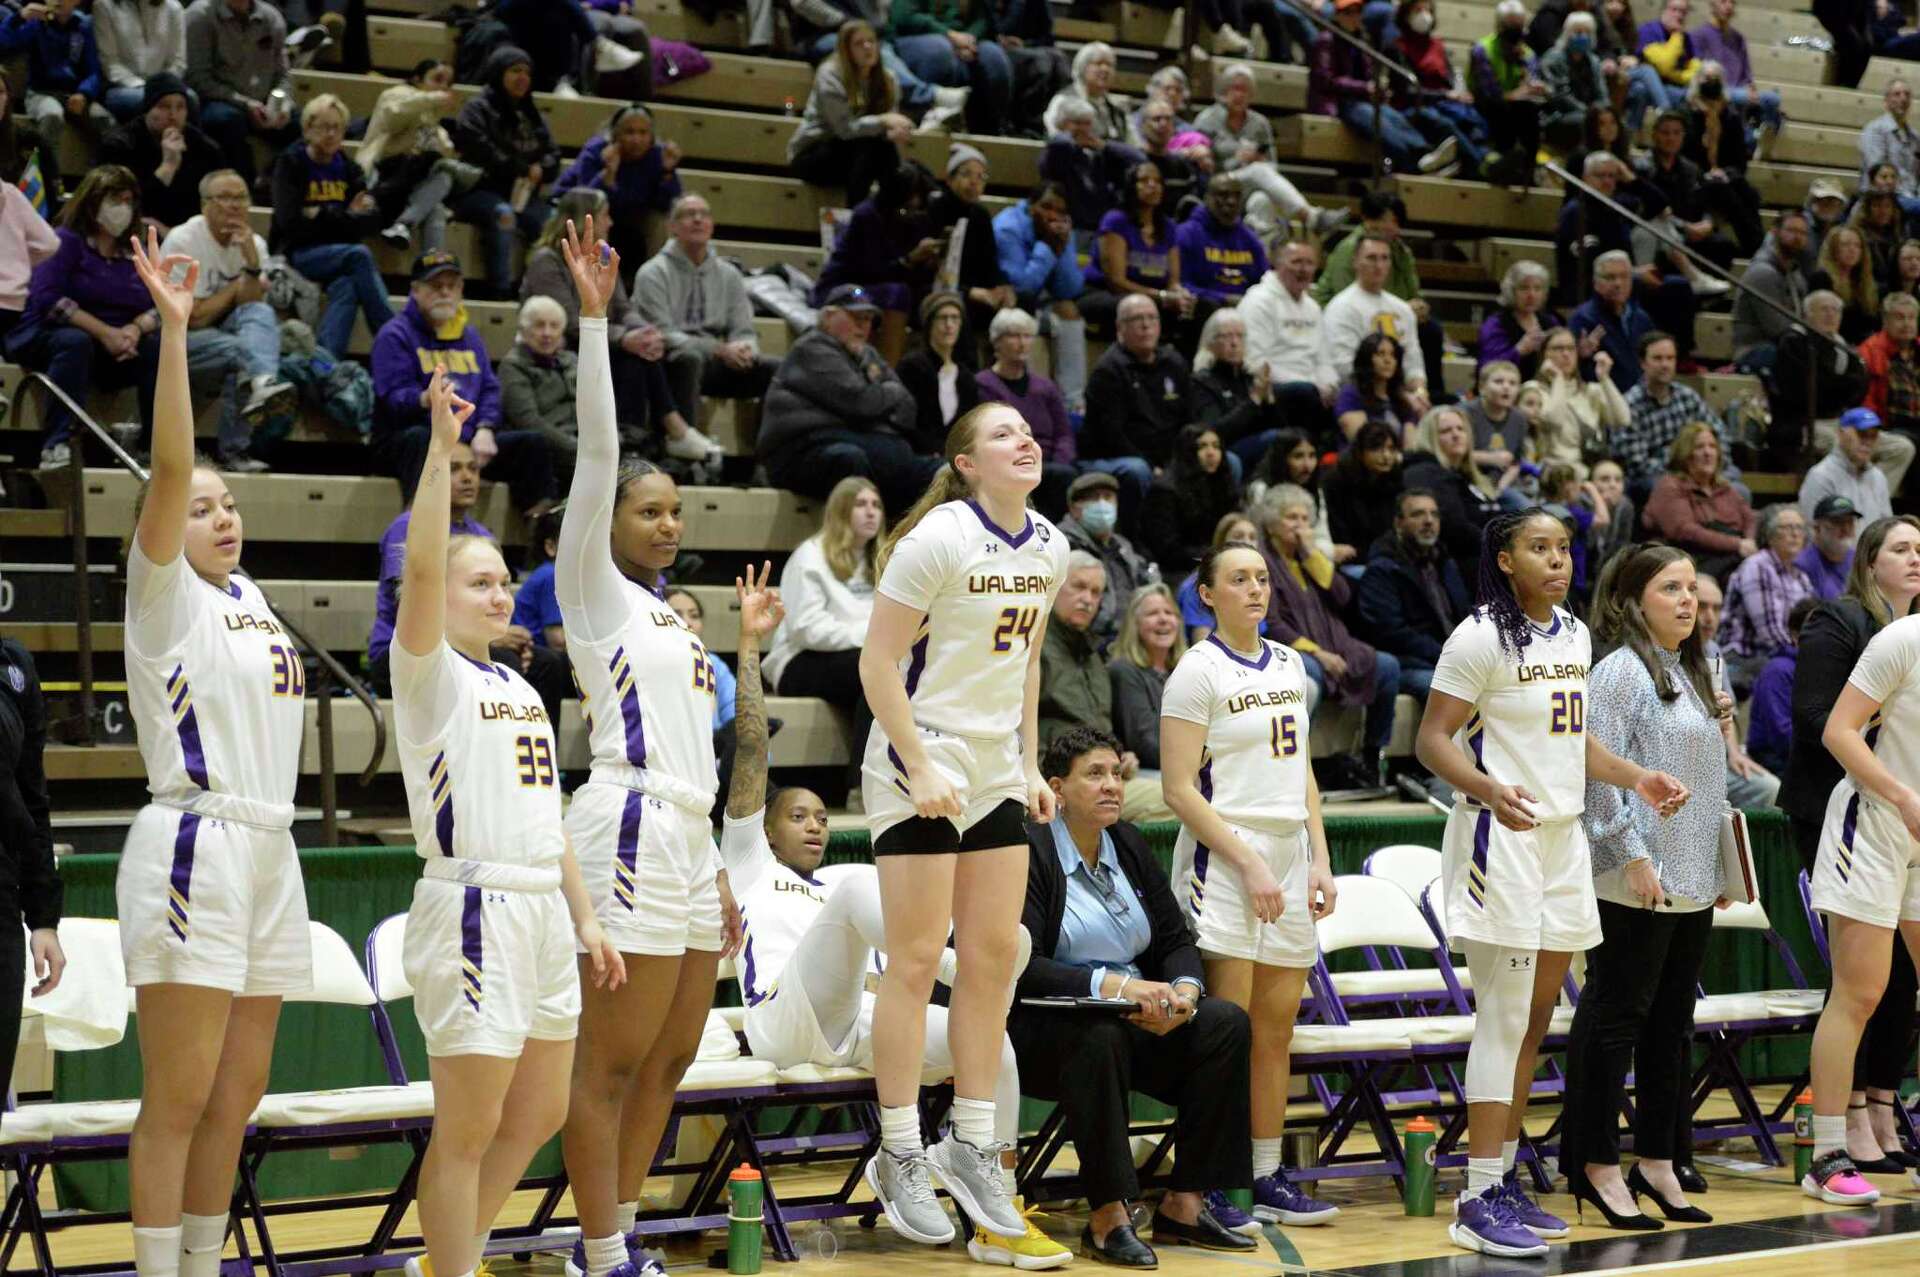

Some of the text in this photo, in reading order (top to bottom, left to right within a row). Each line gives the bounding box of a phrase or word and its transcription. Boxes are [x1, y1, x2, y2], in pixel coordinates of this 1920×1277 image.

[994, 606, 1039, 654] 24
[269, 644, 305, 698] 30
[104, 700, 123, 734] C
[1549, 690, 1584, 734] 20
[1270, 714, 1298, 758] 15
[515, 734, 555, 787] 33
